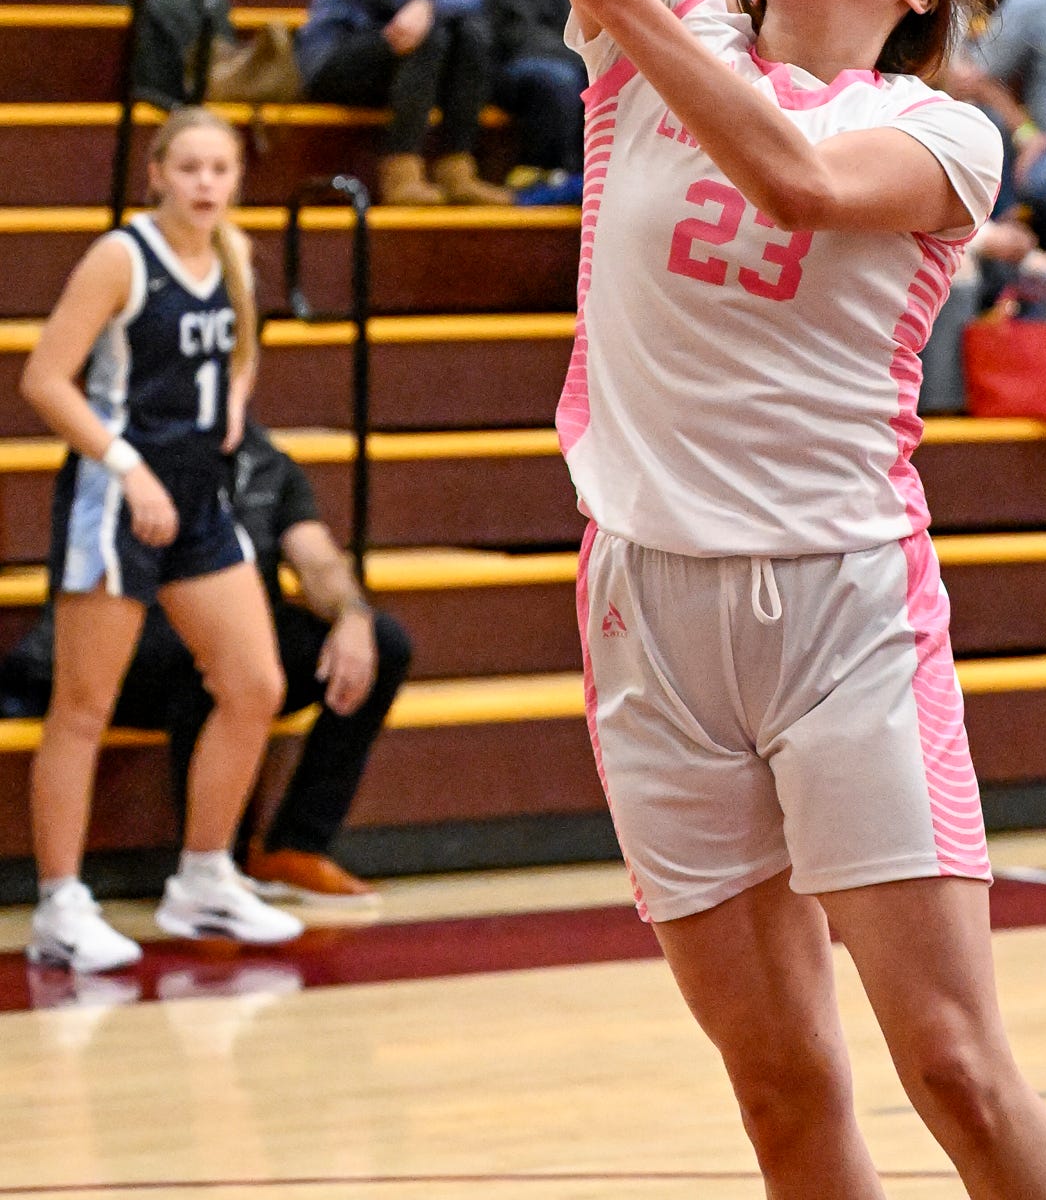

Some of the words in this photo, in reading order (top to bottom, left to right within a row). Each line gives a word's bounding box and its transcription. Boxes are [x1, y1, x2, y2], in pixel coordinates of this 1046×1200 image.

[667, 178, 814, 301] 23
[179, 307, 237, 357] CVC
[196, 360, 219, 431] 1
